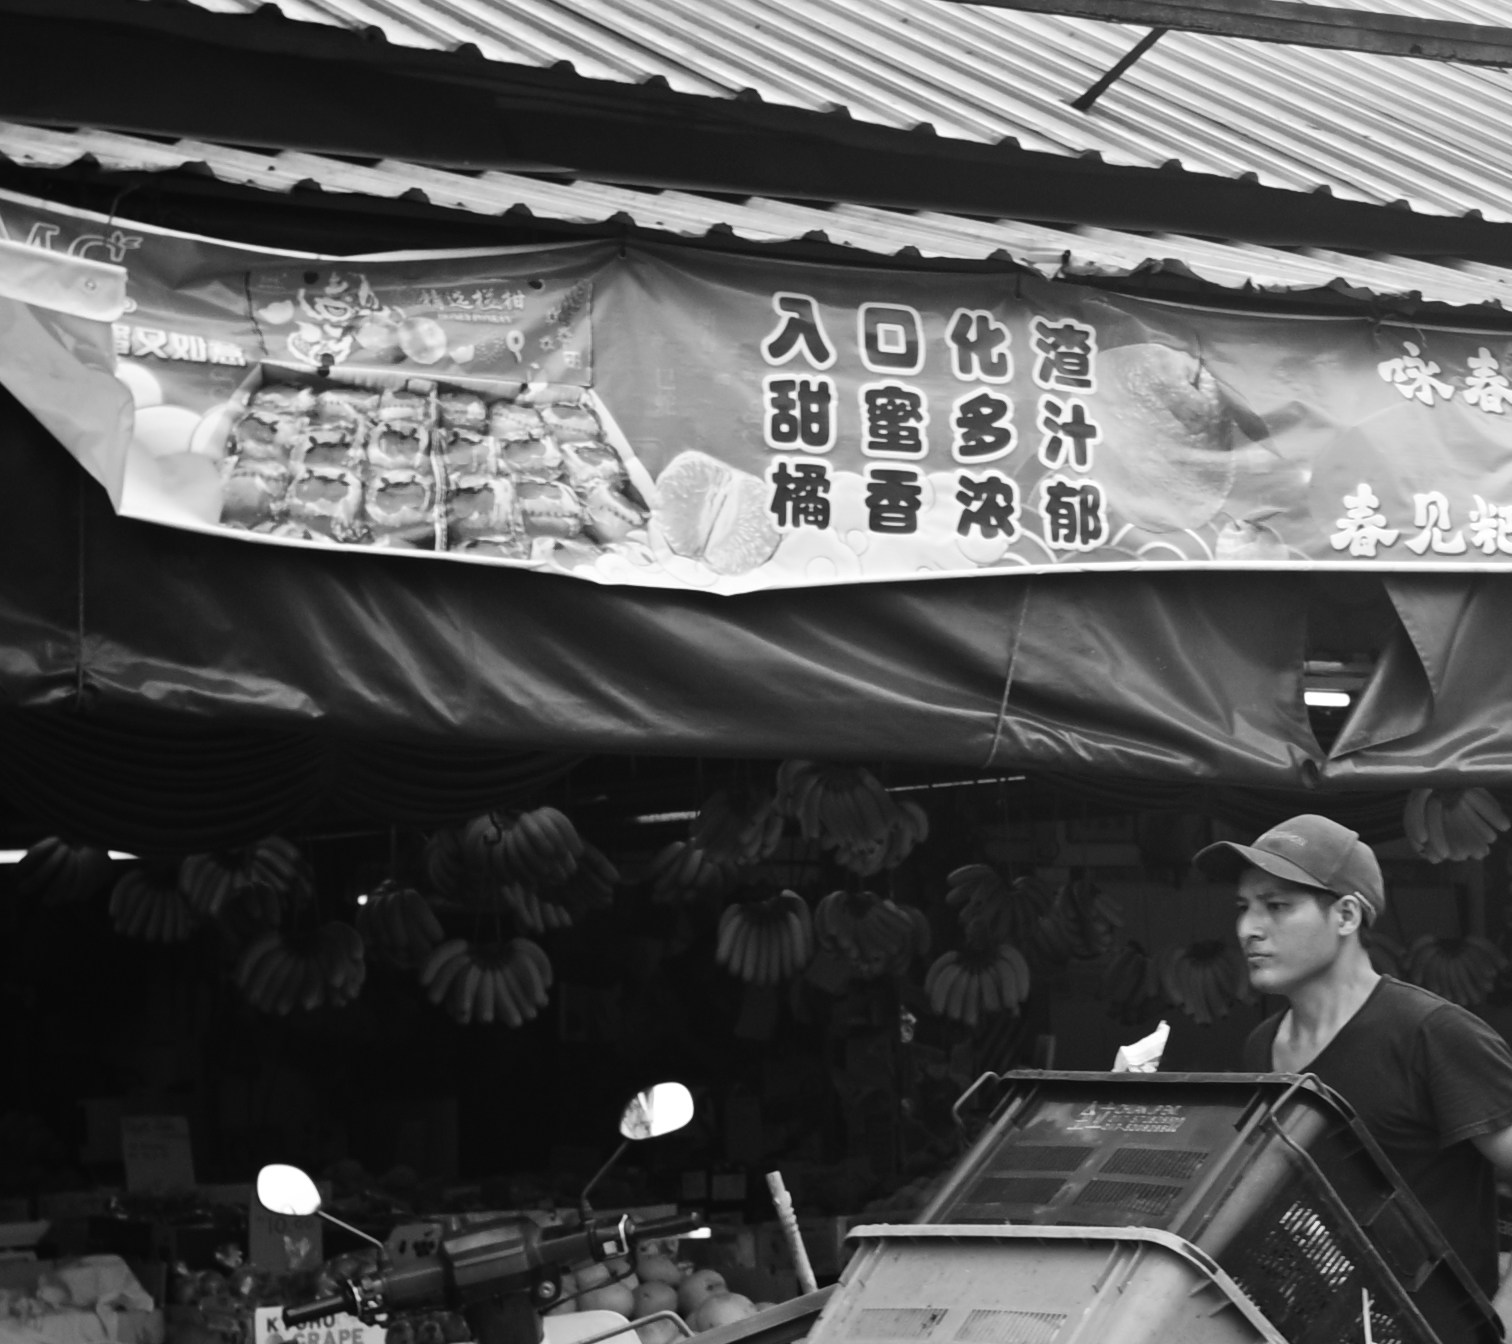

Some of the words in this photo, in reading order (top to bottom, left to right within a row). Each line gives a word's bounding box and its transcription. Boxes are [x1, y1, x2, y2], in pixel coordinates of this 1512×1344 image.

[763, 292, 1096, 390] 入口化渣
[763, 380, 1098, 471] 甜蜜多汁
[769, 463, 1106, 551] 橘香浓郁
